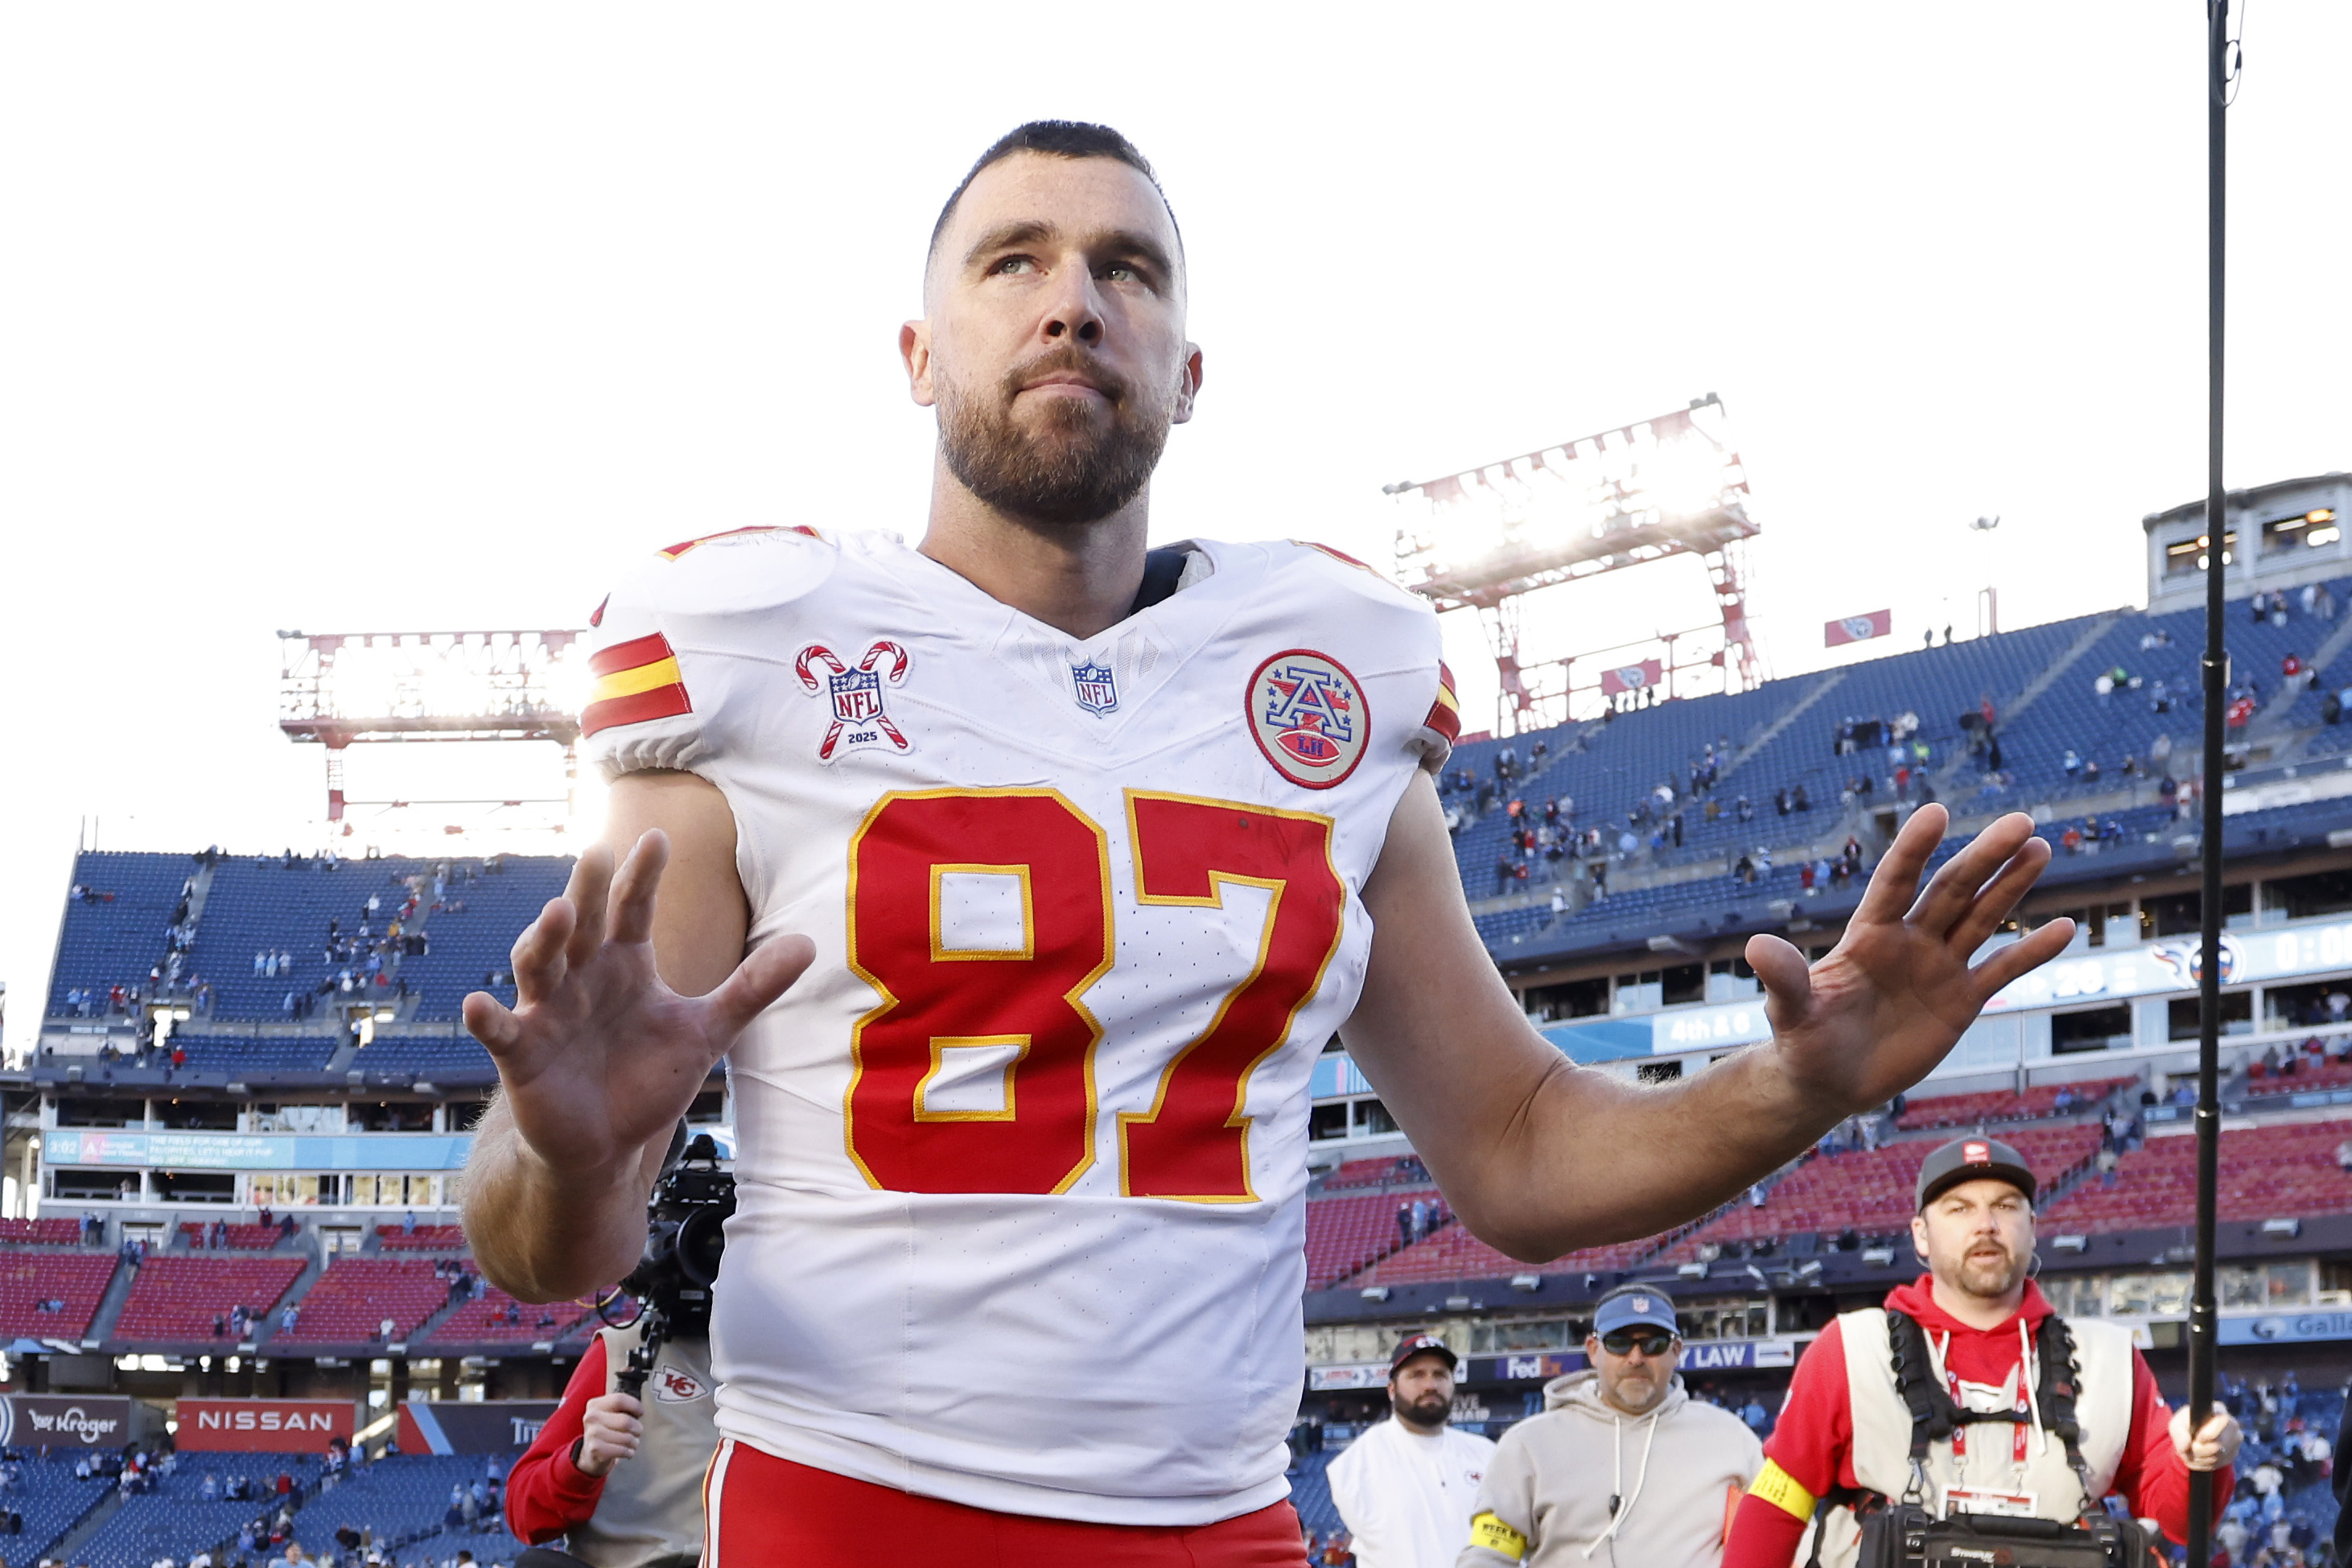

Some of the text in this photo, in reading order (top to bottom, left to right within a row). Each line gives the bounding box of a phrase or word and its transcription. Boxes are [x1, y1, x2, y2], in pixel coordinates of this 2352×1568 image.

[836, 691, 879, 719] NFL
[1079, 683, 1113, 706] NFL
[847, 731, 878, 744] 2025
[1296, 736, 1324, 756] LH
[845, 787, 1347, 1204] 87
[1670, 1018, 1711, 1042] 4th
[1714, 1014, 1730, 1036] &
[1506, 1356, 1563, 1380] FedEx
[1695, 1345, 1747, 1368] LAW
[665, 1373, 696, 1397] KC
[56, 1406, 117, 1443] Kroger
[198, 1410, 333, 1432] NISSAN
